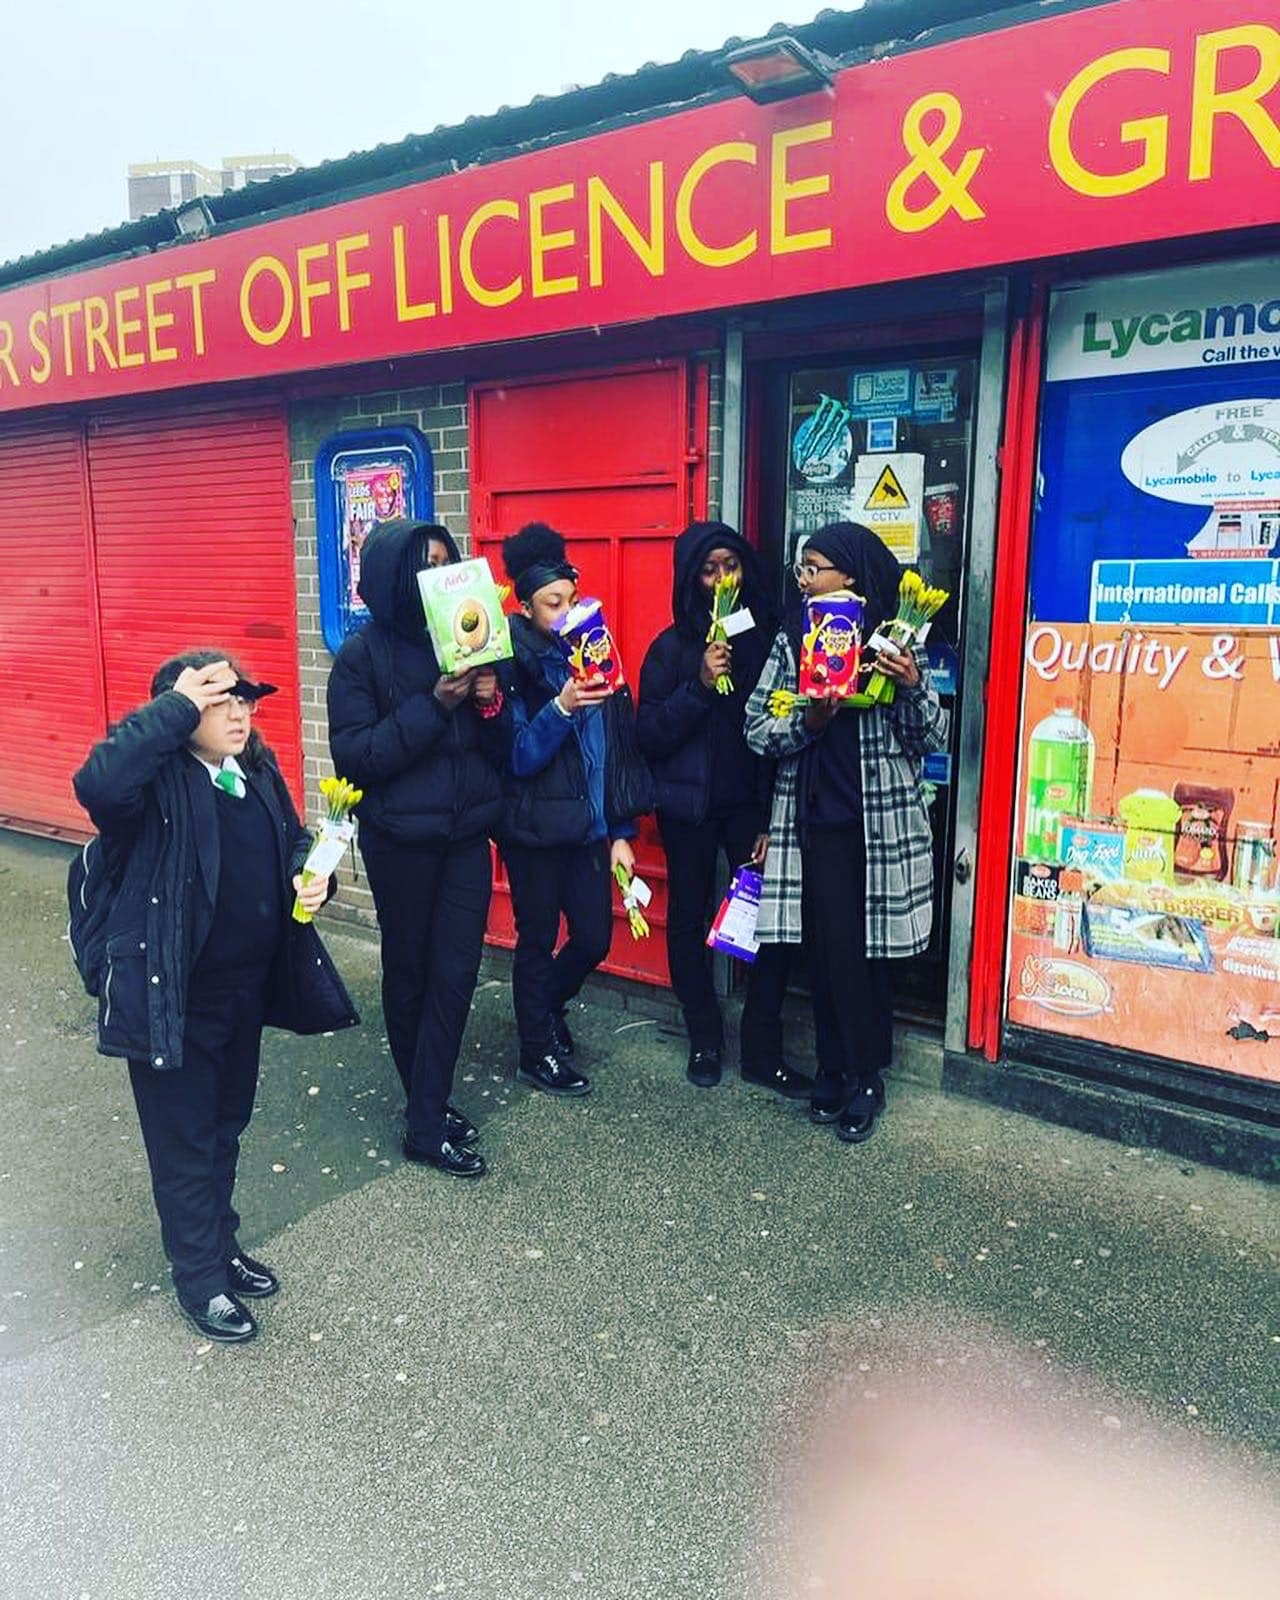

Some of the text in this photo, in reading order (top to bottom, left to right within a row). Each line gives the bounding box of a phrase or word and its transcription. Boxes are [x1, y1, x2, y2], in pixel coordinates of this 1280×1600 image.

[29, 268, 217, 385] STREET
[240, 233, 370, 347] OFF
[393, 120, 832, 322] LICENCE
[885, 91, 986, 234] &
[1048, 24, 1280, 198] GR
[1201, 345, 1236, 364] Call
[1240, 344, 1270, 360] the
[1215, 405, 1265, 420] FREE
[1145, 472, 1217, 488] Lycamobile
[1227, 473, 1241, 482] to
[351, 502, 376, 521] FAIR
[872, 512, 901, 521] CCTV
[1097, 582, 1226, 604] International
[1026, 627, 1187, 690] Quality
[1201, 634, 1246, 680] &
[1023, 885, 1057, 899] BEANS
